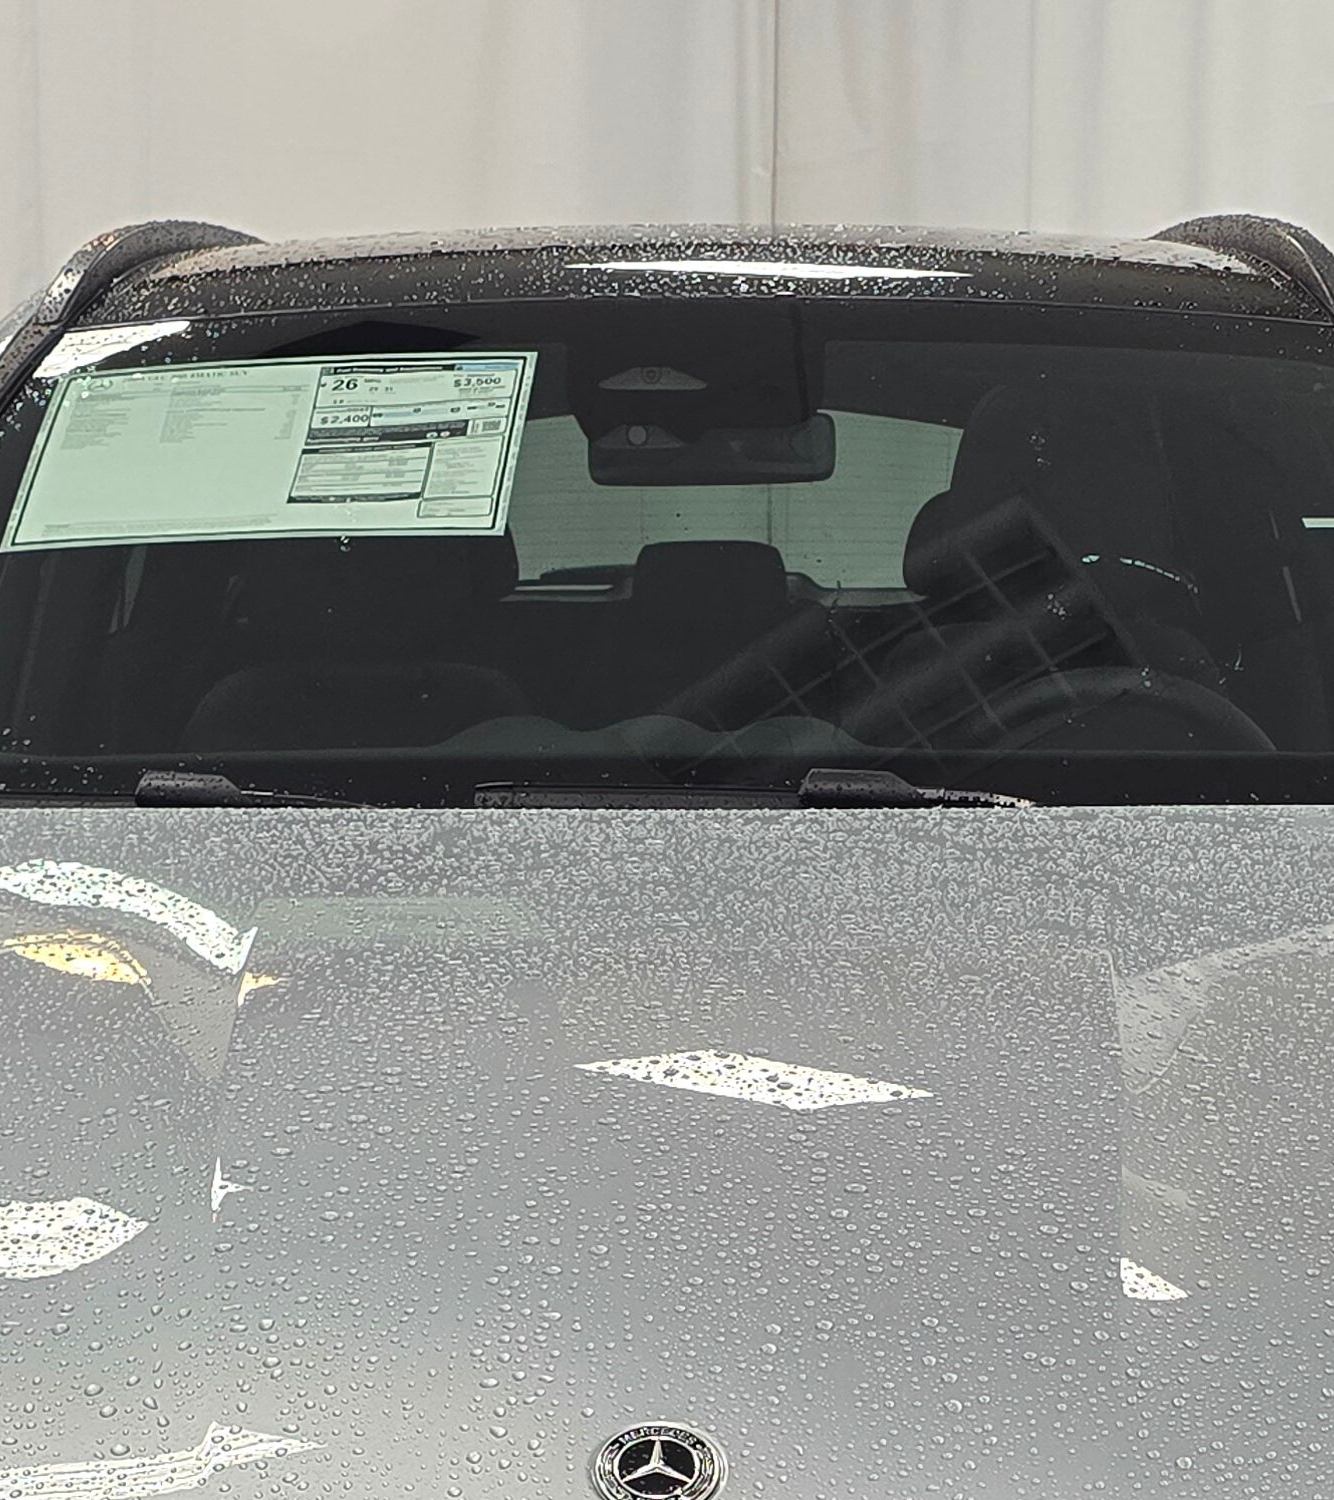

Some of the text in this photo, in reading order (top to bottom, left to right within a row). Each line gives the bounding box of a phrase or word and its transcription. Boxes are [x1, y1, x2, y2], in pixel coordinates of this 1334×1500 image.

[331, 378, 359, 392] 26
[453, 376, 501, 388] $3,500
[320, 414, 369, 425] $2,400
[618, 1427, 697, 1445] MERCEDES
